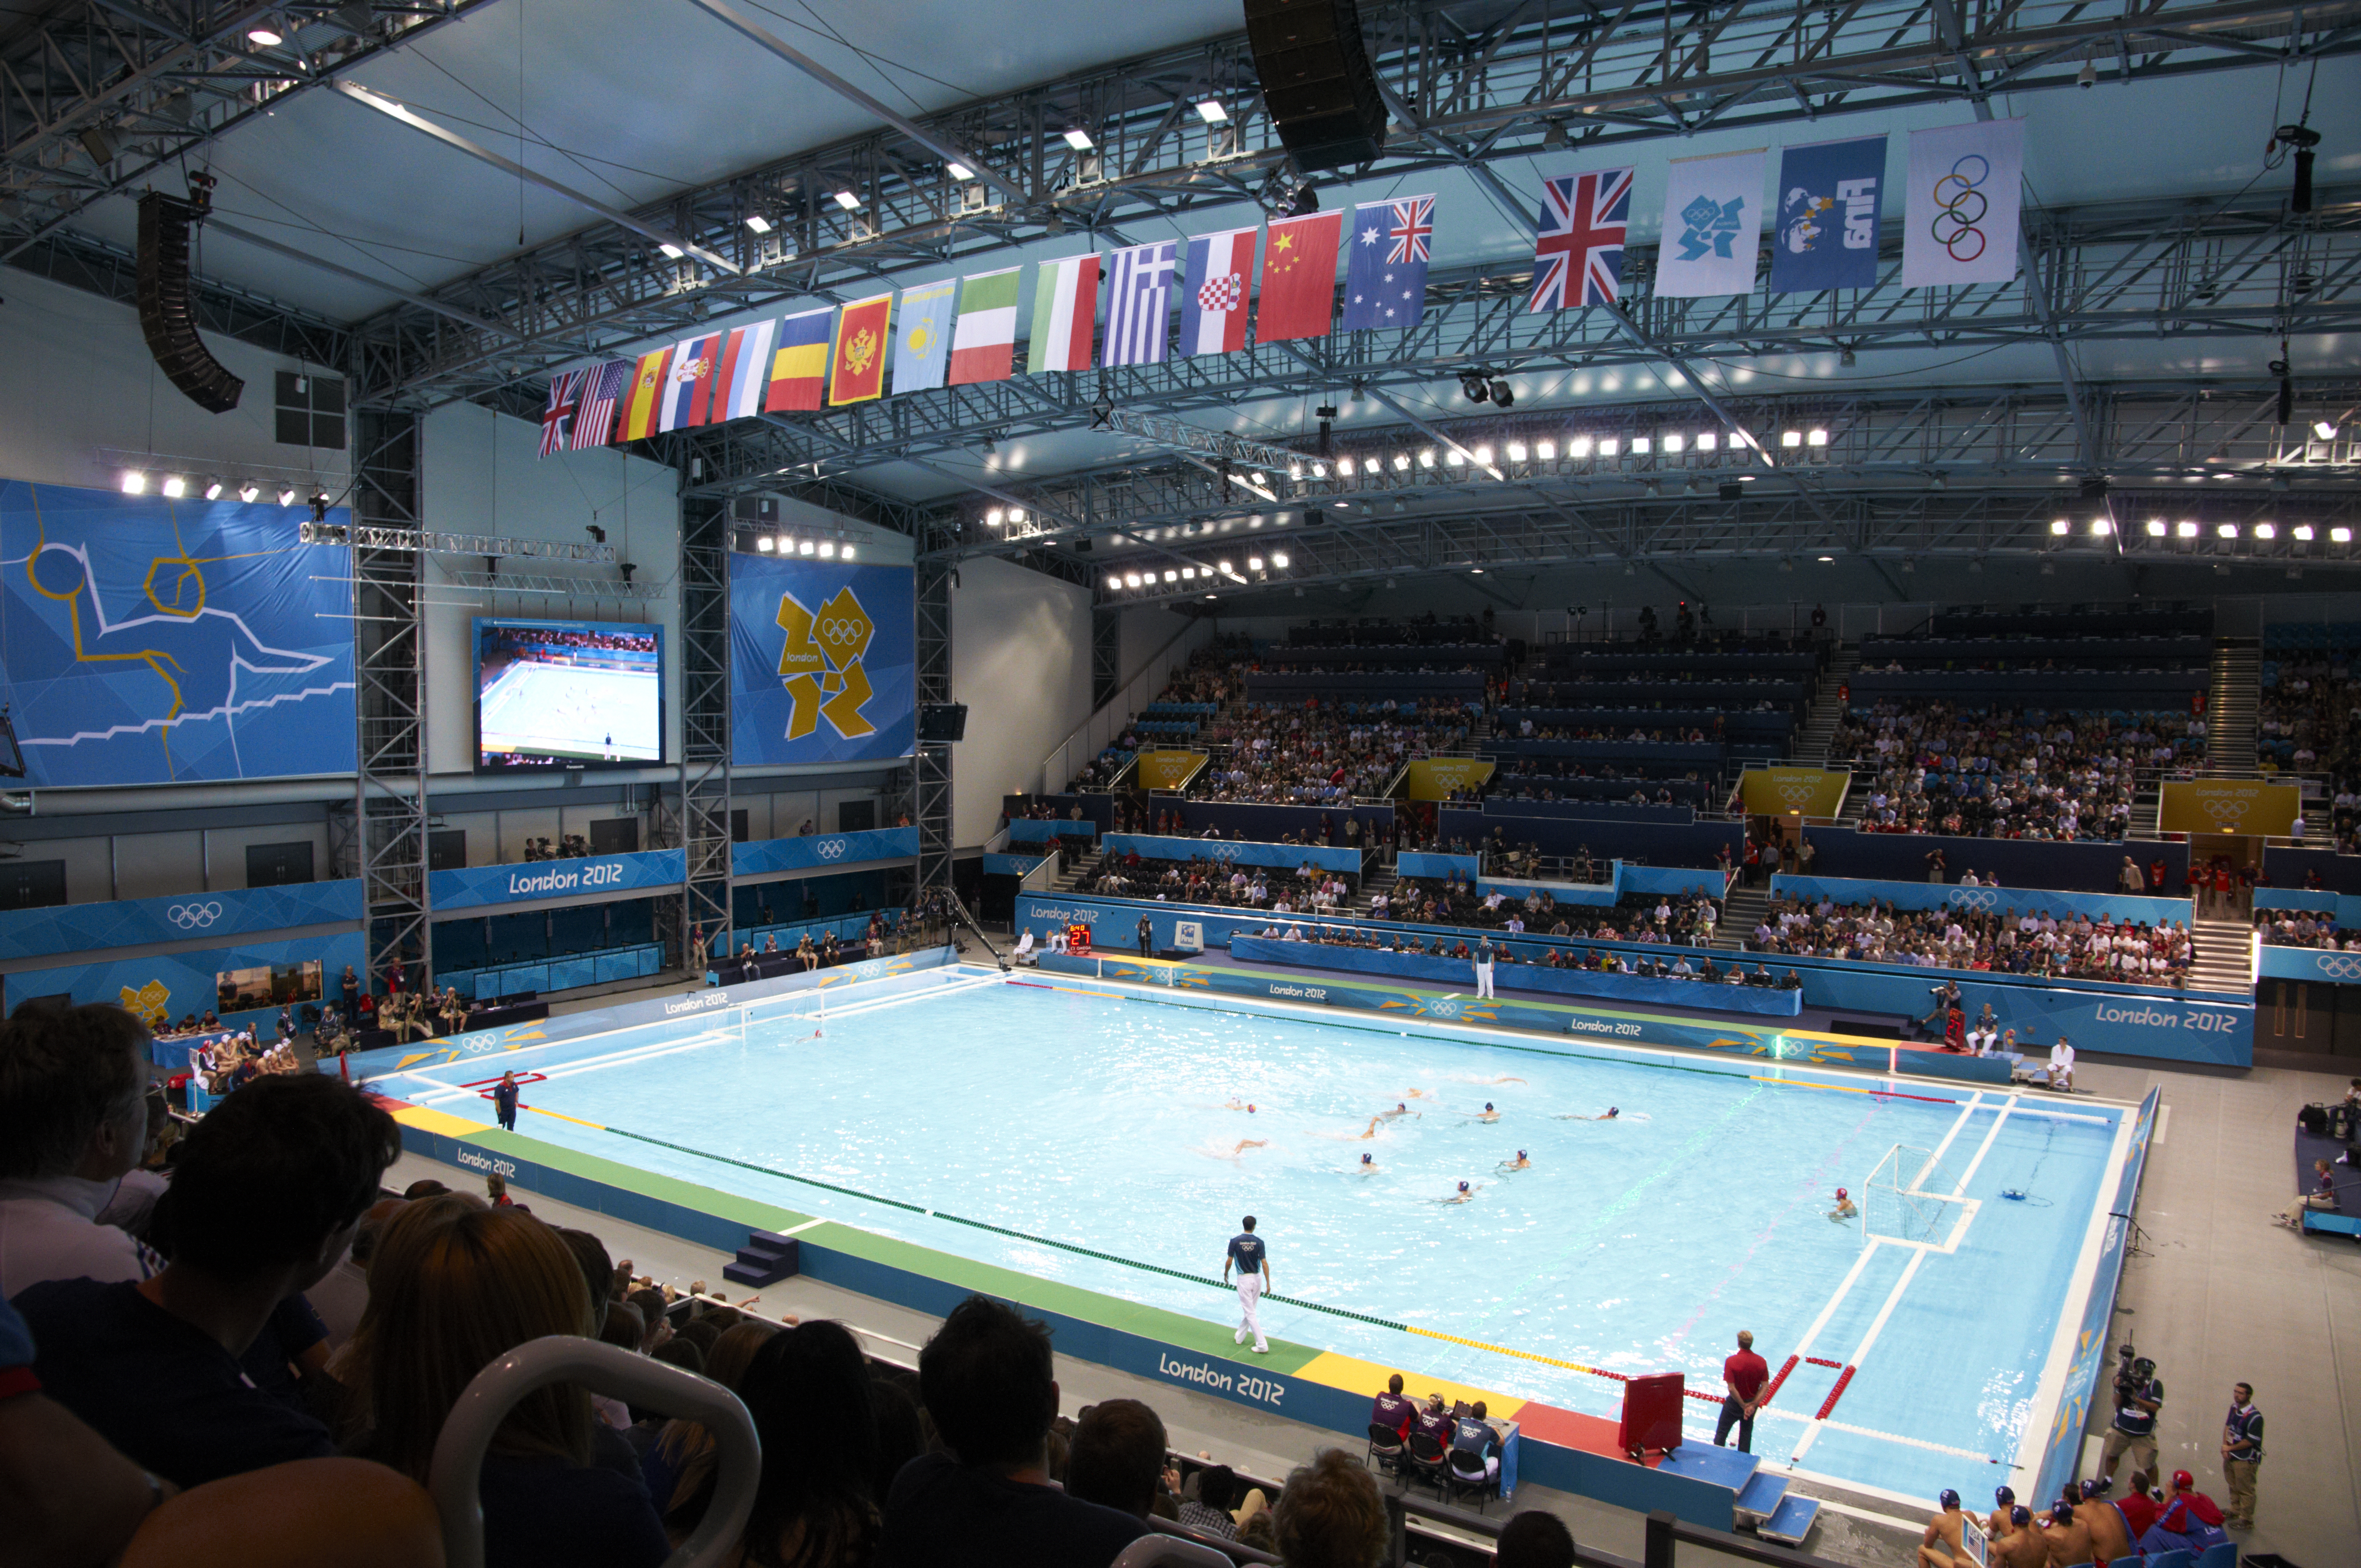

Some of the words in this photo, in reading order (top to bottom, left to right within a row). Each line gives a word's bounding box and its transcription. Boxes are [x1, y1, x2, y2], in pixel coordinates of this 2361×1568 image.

[787, 652, 818, 662] london
[2196, 788, 2234, 796] London
[2236, 788, 2259, 797] 2012
[509, 869, 578, 894] London
[583, 864, 623, 886] 2012
[1031, 905, 1070, 920] London
[1073, 908, 1098, 923] 2012
[1071, 931, 1090, 946] 27
[1270, 983, 1303, 997] London
[1305, 988, 1326, 999] 2012
[665, 999, 704, 1014] London
[705, 992, 728, 1006] 2012
[2096, 1003, 2178, 1028] London
[2183, 1011, 2238, 1033] 2012
[1572, 1019, 1613, 1033] London
[1615, 1023, 1641, 1036] 2012
[1946, 1019, 1961, 1038] 27
[458, 1147, 492, 1171] London
[493, 1158, 515, 1178] 2012
[1160, 1353, 1232, 1391] London
[1237, 1374, 1285, 1406] 2012
[1998, 1487, 2004, 1495] 3
[1969, 1527, 1981, 1542] USA
